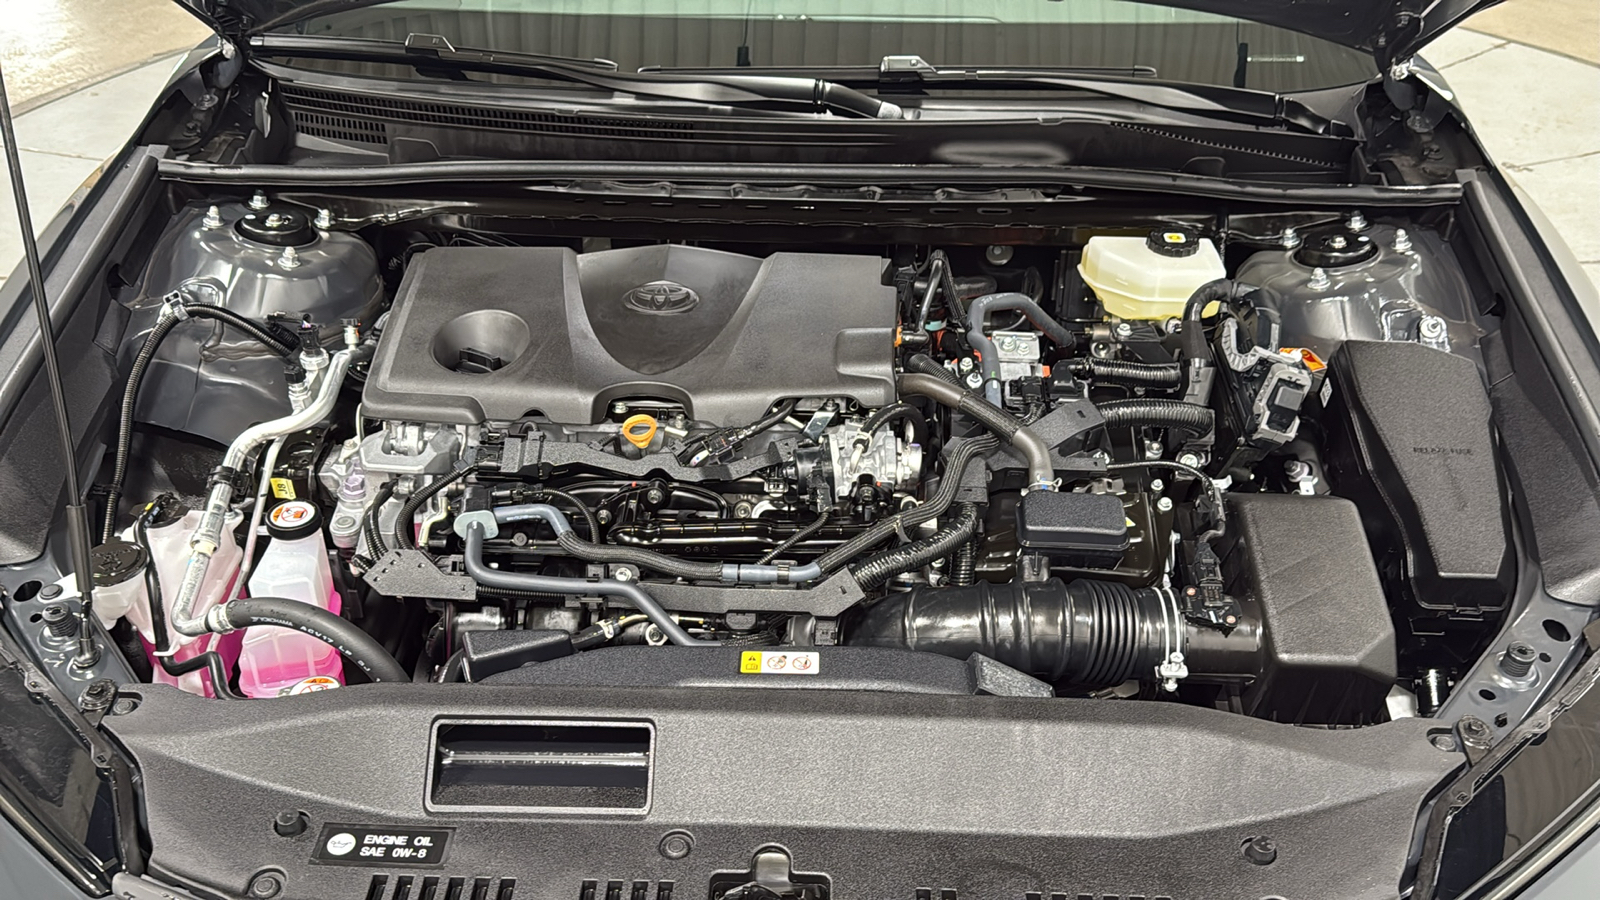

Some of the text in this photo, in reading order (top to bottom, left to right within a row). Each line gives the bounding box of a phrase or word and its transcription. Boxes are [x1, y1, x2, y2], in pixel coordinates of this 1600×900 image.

[250, 616, 294, 627] YOKOHAMA
[363, 834, 434, 847] ENGINE OIL
[359, 846, 427, 859] SAE 0W-8
